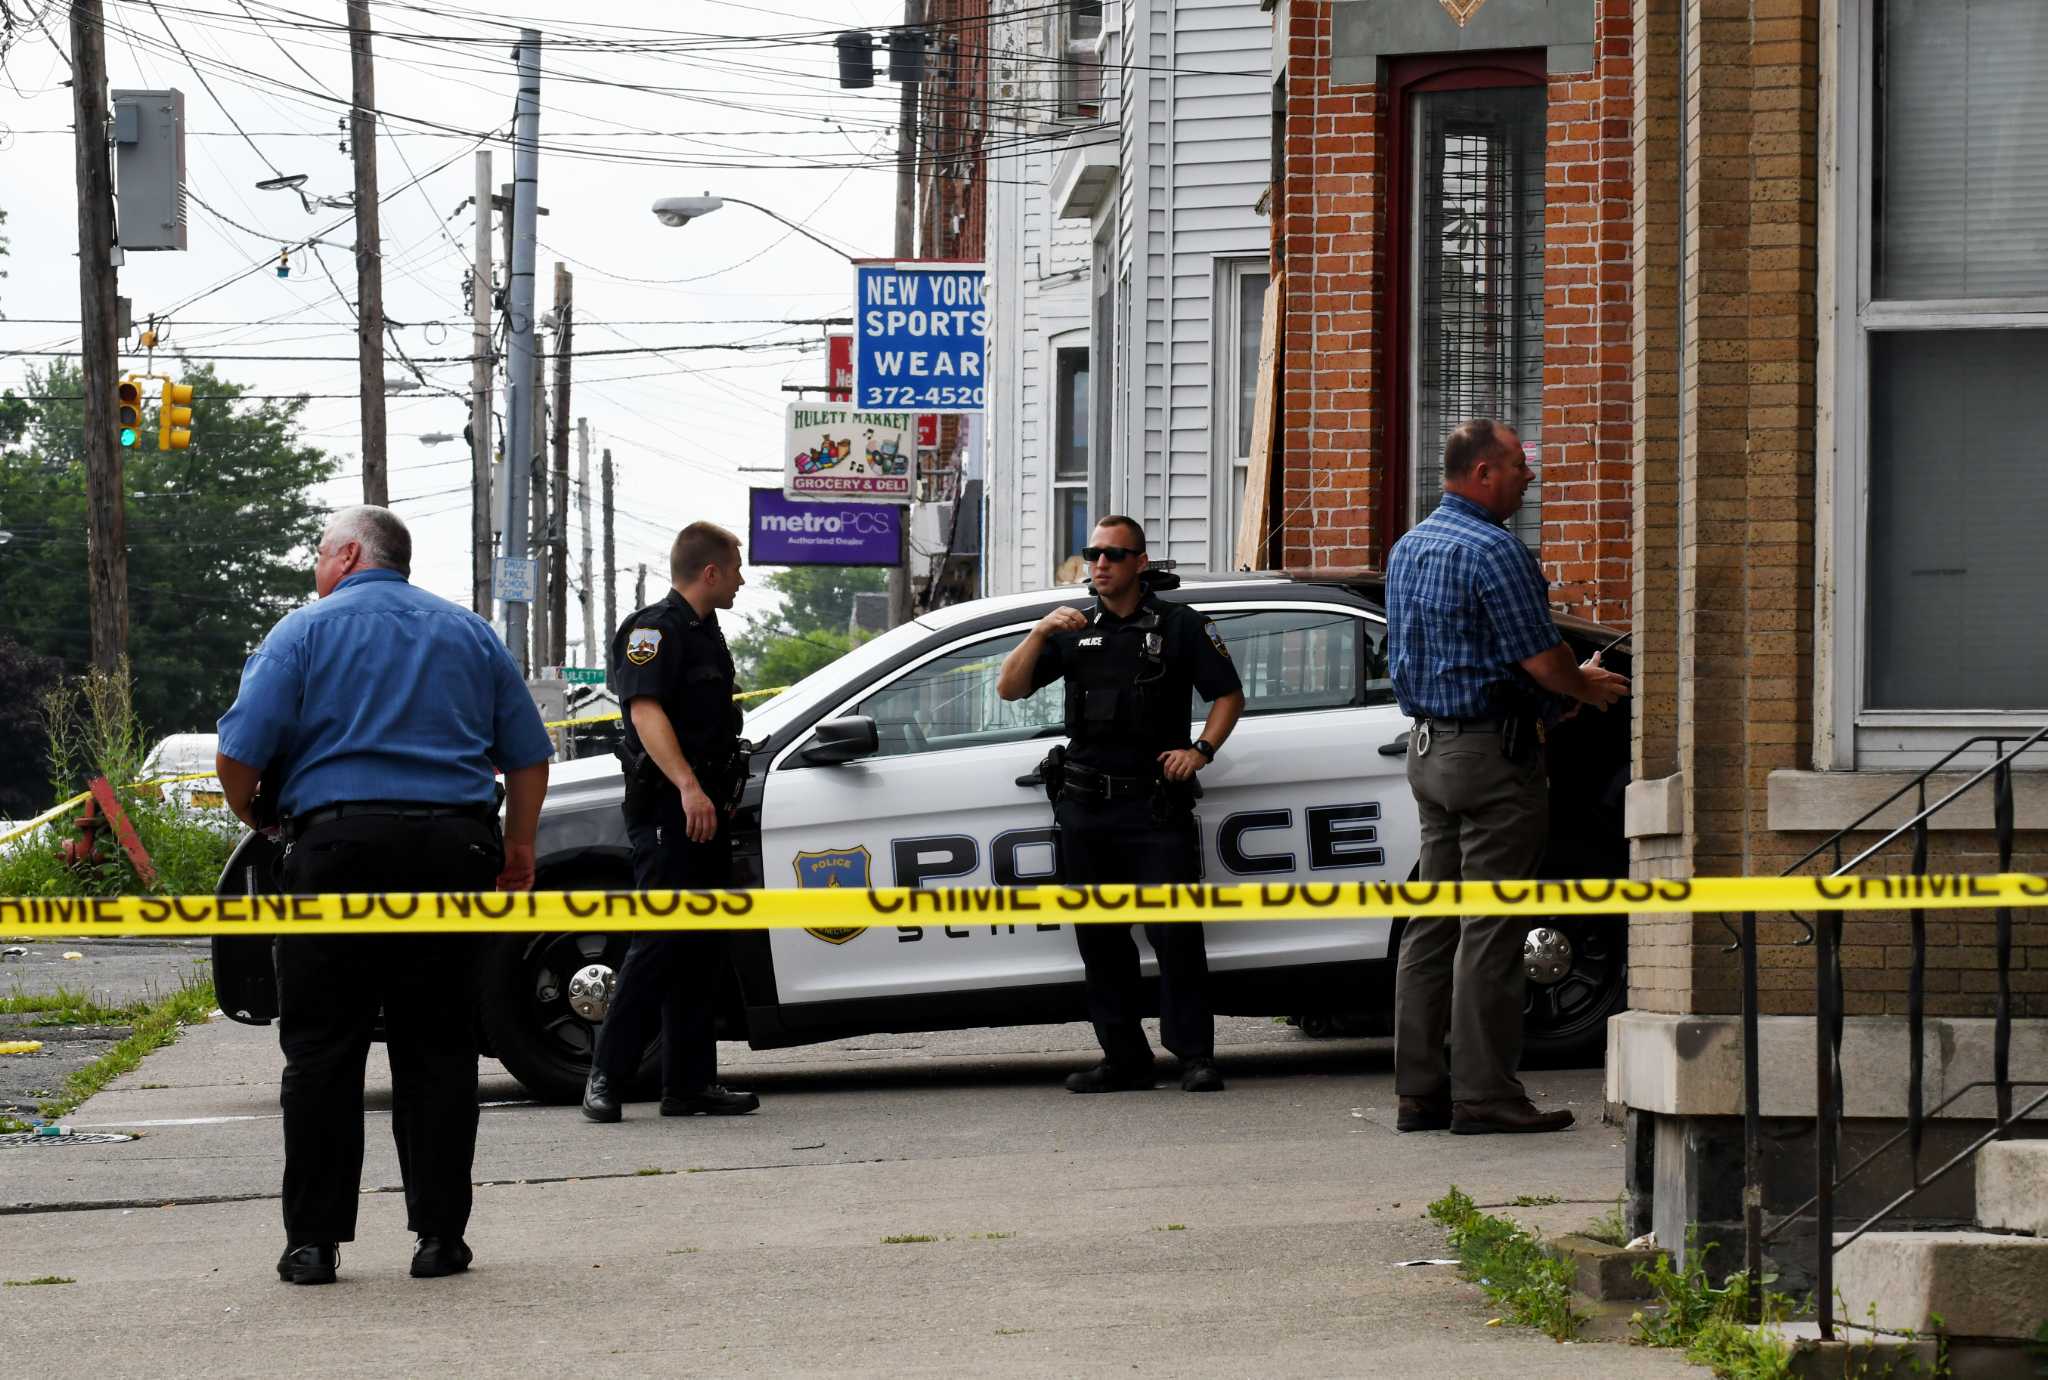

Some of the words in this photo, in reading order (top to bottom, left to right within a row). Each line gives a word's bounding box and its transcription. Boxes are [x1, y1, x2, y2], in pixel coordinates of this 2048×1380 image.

[867, 275, 919, 305] NEW
[929, 275, 986, 305] YORK
[866, 310, 986, 336] SPORTS
[873, 351, 981, 376] WEAR
[866, 386, 985, 405] 372-4520
[794, 410, 848, 429] HULETT
[852, 412, 910, 431] MARKET
[795, 478, 860, 489] GROCERY
[863, 480, 873, 490] &
[876, 480, 906, 491] DELI
[760, 512, 890, 534] metroPCS
[787, 536, 834, 545] Authorized
[836, 537, 865, 546] Dealer
[1078, 636, 1103, 647] POLICE
[891, 802, 1385, 888] POCE
[811, 857, 852, 873] POLICE
[0, 896, 124, 924] RIME
